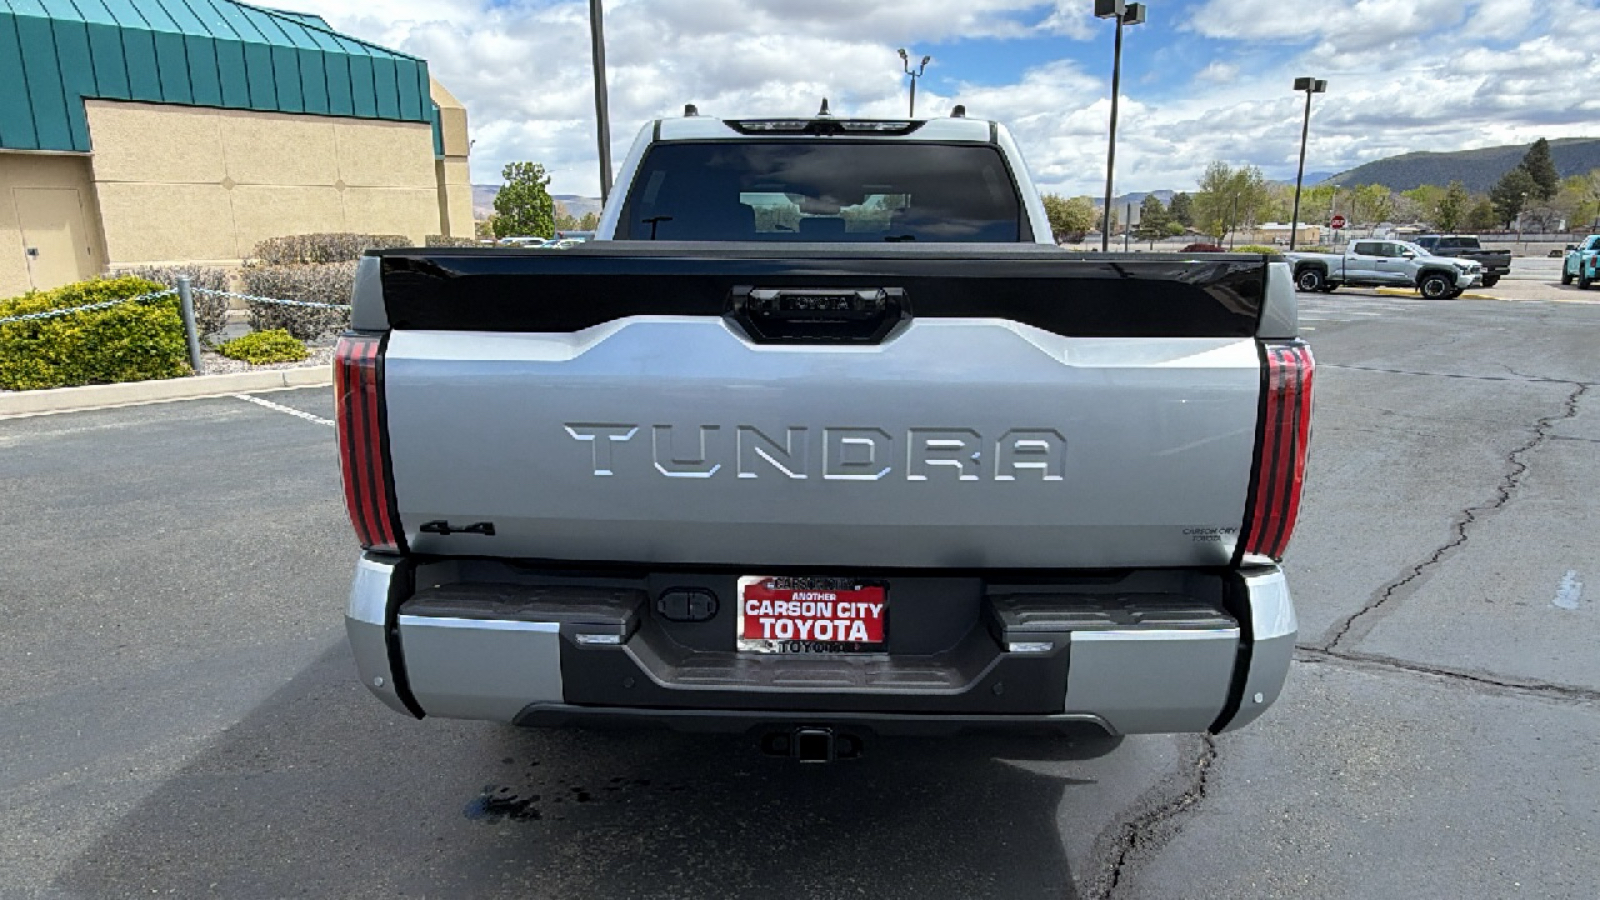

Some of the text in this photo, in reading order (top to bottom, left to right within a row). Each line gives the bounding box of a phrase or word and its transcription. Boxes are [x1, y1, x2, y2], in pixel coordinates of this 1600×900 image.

[786, 296, 850, 310] TOYOTA
[564, 421, 1067, 482] TUNDRA
[792, 592, 837, 601] ANOTHER
[745, 600, 883, 618] CARSON CITY
[759, 618, 869, 641] TOYOTA
